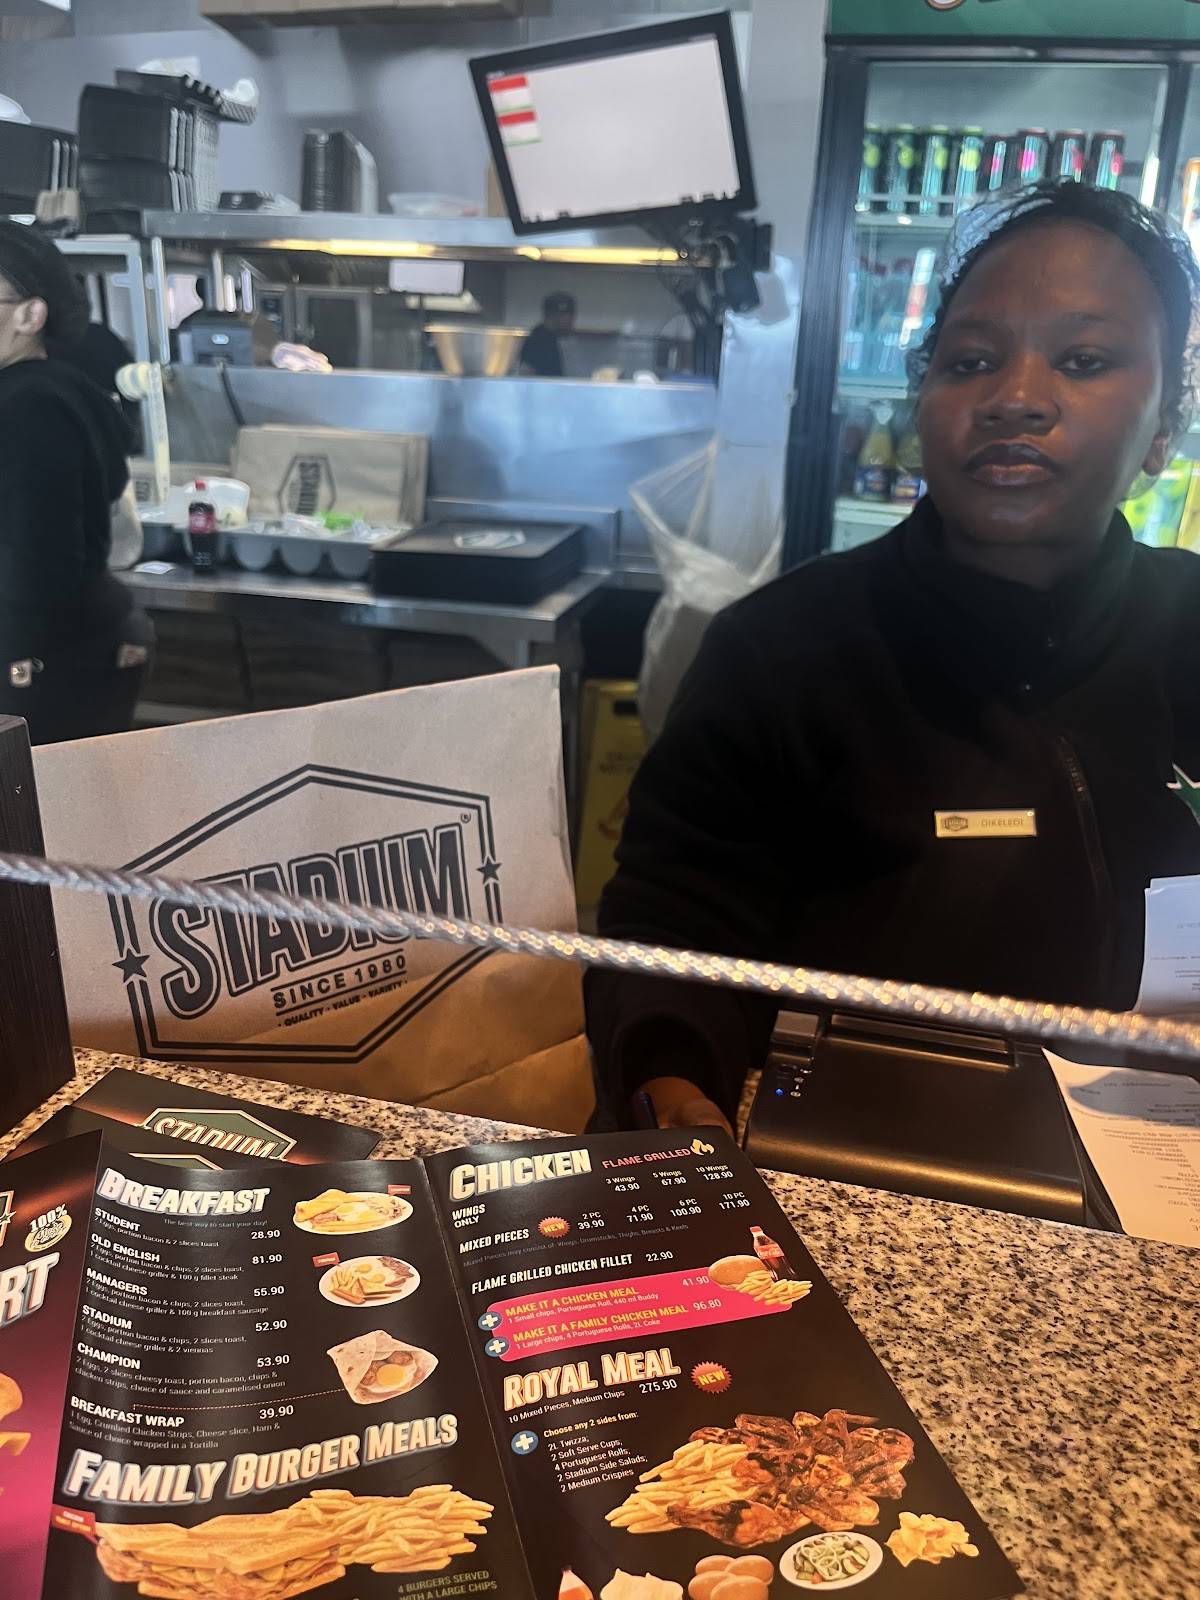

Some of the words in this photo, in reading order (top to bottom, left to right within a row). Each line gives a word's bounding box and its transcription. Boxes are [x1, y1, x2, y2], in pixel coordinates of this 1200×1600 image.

[148, 822, 472, 1021] STADIUM
[273, 972, 346, 1008] SINCE
[355, 955, 406, 982] 1980
[285, 1008, 324, 1026] QUALITY
[333, 995, 360, 1010] VALUE
[368, 981, 402, 997] VARIETY
[602, 1156, 643, 1168] FLAME
[644, 1148, 691, 1162] GRILLED
[450, 1149, 592, 1201] CHICKEN
[612, 1176, 636, 1184] Wings
[659, 1169, 682, 1177] Wings
[706, 1164, 728, 1172] Wings
[615, 1182, 640, 1192] 43.90
[661, 1176, 686, 1186] 67.90
[703, 1171, 733, 1181] 128.90
[97, 1168, 270, 1216] BREAKFAST
[29, 1204, 68, 1233] 100%
[452, 1204, 486, 1221] WINGS
[578, 1220, 605, 1230] 39.90
[627, 1213, 654, 1223] 71.90
[670, 1206, 702, 1217] 100.90
[719, 1199, 750, 1210] 171.90
[638, 1204, 650, 1212] PC
[95, 1208, 140, 1232] STUDENT
[454, 1215, 480, 1228] ONLY
[543, 1222, 565, 1232] NEW
[251, 1230, 280, 1240] 28.90
[459, 1238, 492, 1253] MIXED
[494, 1229, 529, 1245] PIECES
[91, 1233, 111, 1249] OLD
[113, 1242, 160, 1262] ENGLISH
[252, 1254, 282, 1264] 81.90
[646, 1251, 673, 1262] 22.90
[87, 1268, 148, 1295] MANAGERS
[472, 1275, 507, 1294] FLAME
[509, 1266, 552, 1284] GRILLED
[554, 1258, 598, 1276] CHICKEN
[600, 1254, 632, 1268] FILLET
[682, 1275, 709, 1286] 41.90
[254, 1286, 284, 1296] 55.90
[506, 1303, 537, 1316] MAKE
[539, 1300, 549, 1309] IT
[552, 1297, 559, 1307] A
[561, 1290, 608, 1306] CHICKEN
[610, 1286, 638, 1298] MEAL
[514, 1313, 536, 1323] Small
[537, 1309, 556, 1320] chips,
[558, 1302, 596, 1314] Portuguese
[598, 1300, 612, 1308] Roll,
[614, 1297, 626, 1305] 440
[638, 1292, 658, 1302] Buddy
[693, 1299, 722, 1311] 96.80
[82, 1305, 132, 1329] STADIUM
[255, 1320, 288, 1332] 52.90
[513, 1328, 546, 1342] MAKE
[548, 1324, 558, 1335] IT
[560, 1322, 569, 1332] A
[571, 1317, 608, 1330] FAMILY
[611, 1308, 658, 1324] CHICKEN
[660, 1304, 688, 1317] MEAL
[522, 1338, 543, 1349] Large
[544, 1334, 565, 1345] chips,
[572, 1325, 612, 1338] Portuguese
[613, 1322, 632, 1331] Rolls,
[643, 1319, 661, 1327] Coke
[77, 1342, 141, 1370] CHAMPION
[257, 1355, 290, 1367] 53.90
[503, 1361, 599, 1411] ROYAL
[601, 1347, 681, 1386] MEAL
[639, 1379, 677, 1394] 275.90
[697, 1370, 726, 1385] NEW
[71, 1396, 142, 1424] BREAKFAST
[145, 1415, 185, 1427] WRAP
[259, 1405, 294, 1419] 39.90
[509, 1415, 518, 1424] 10
[520, 1408, 543, 1420] Mixed
[544, 1400, 572, 1413] Pieces,
[573, 1394, 602, 1406] Medium
[604, 1389, 625, 1400] Chips
[543, 1425, 573, 1438] Choose
[575, 1421, 589, 1431] any
[590, 1419, 596, 1427] 2
[597, 1414, 617, 1425] sides
[618, 1411, 639, 1420] from:
[63, 1448, 227, 1506] FAMILY
[228, 1440, 360, 1500] BURGER
[362, 1413, 458, 1463] MEALS
[551, 1453, 556, 1461] 2
[558, 1449, 575, 1459] Soft
[577, 1443, 599, 1456] Serve
[555, 1463, 560, 1471] 4
[562, 1452, 606, 1470] Portuguese
[561, 1484, 566, 1492] 2
[568, 1476, 601, 1490] Medium
[602, 1469, 634, 1483] Crispies
[564, 1464, 598, 1480] Stadium
[599, 1460, 617, 1471] Side
[398, 1585, 404, 1593] 4
[406, 1576, 452, 1592] BURGERS
[453, 1570, 489, 1582] SERVED
[427, 1591, 433, 1599] A
[436, 1585, 466, 1597] LARGE
[468, 1581, 497, 1592] CHIPS
